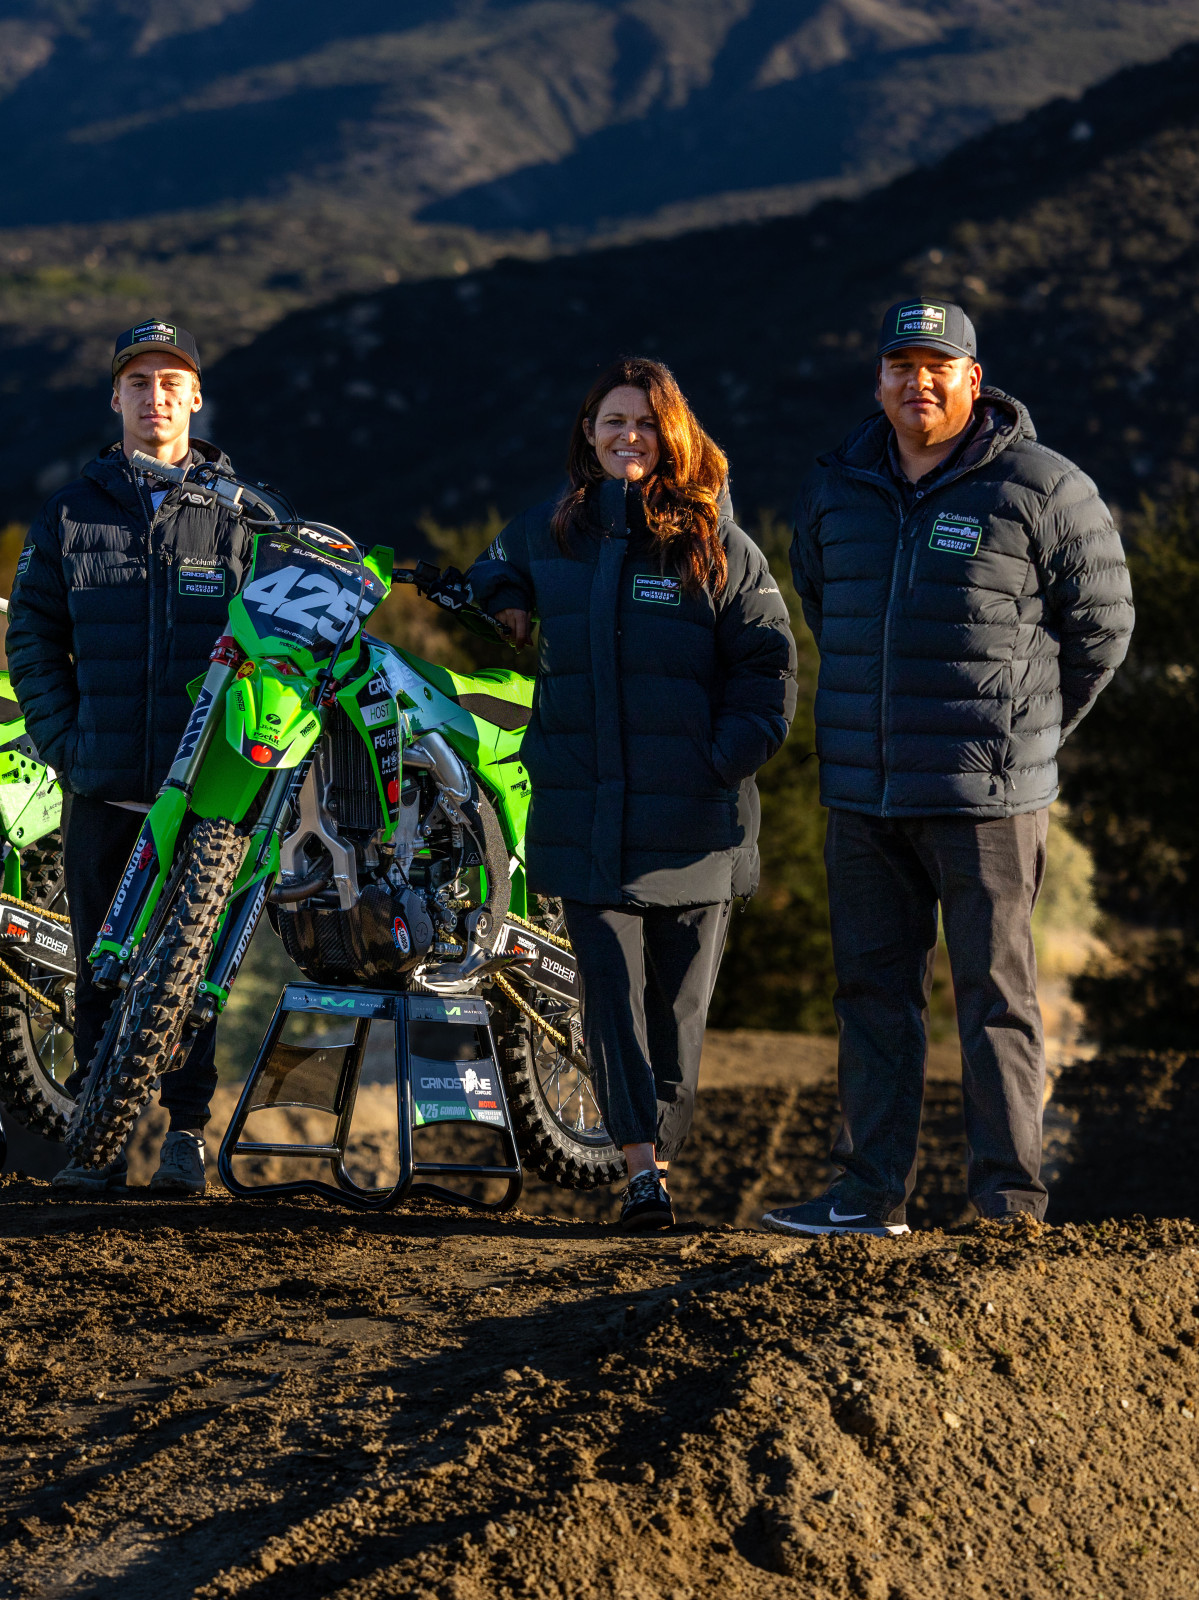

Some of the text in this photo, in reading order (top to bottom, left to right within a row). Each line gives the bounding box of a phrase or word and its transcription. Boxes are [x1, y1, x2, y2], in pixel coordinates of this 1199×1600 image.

[180, 492, 213, 506] ASV
[946, 513, 979, 524] Columbia
[292, 548, 354, 577] SUPERCROSS
[243, 566, 375, 645] 425
[431, 592, 463, 610] ASV
[370, 704, 389, 721] HOST
[254, 732, 280, 746] rockit
[374, 734, 387, 750] FG
[114, 836, 147, 917] DUNLOP
[234, 884, 266, 969] DUNLOP
[36, 933, 68, 956] SYPHER
[541, 957, 576, 984] SYPHER
[419, 1103, 466, 1119] 425 GORDON
